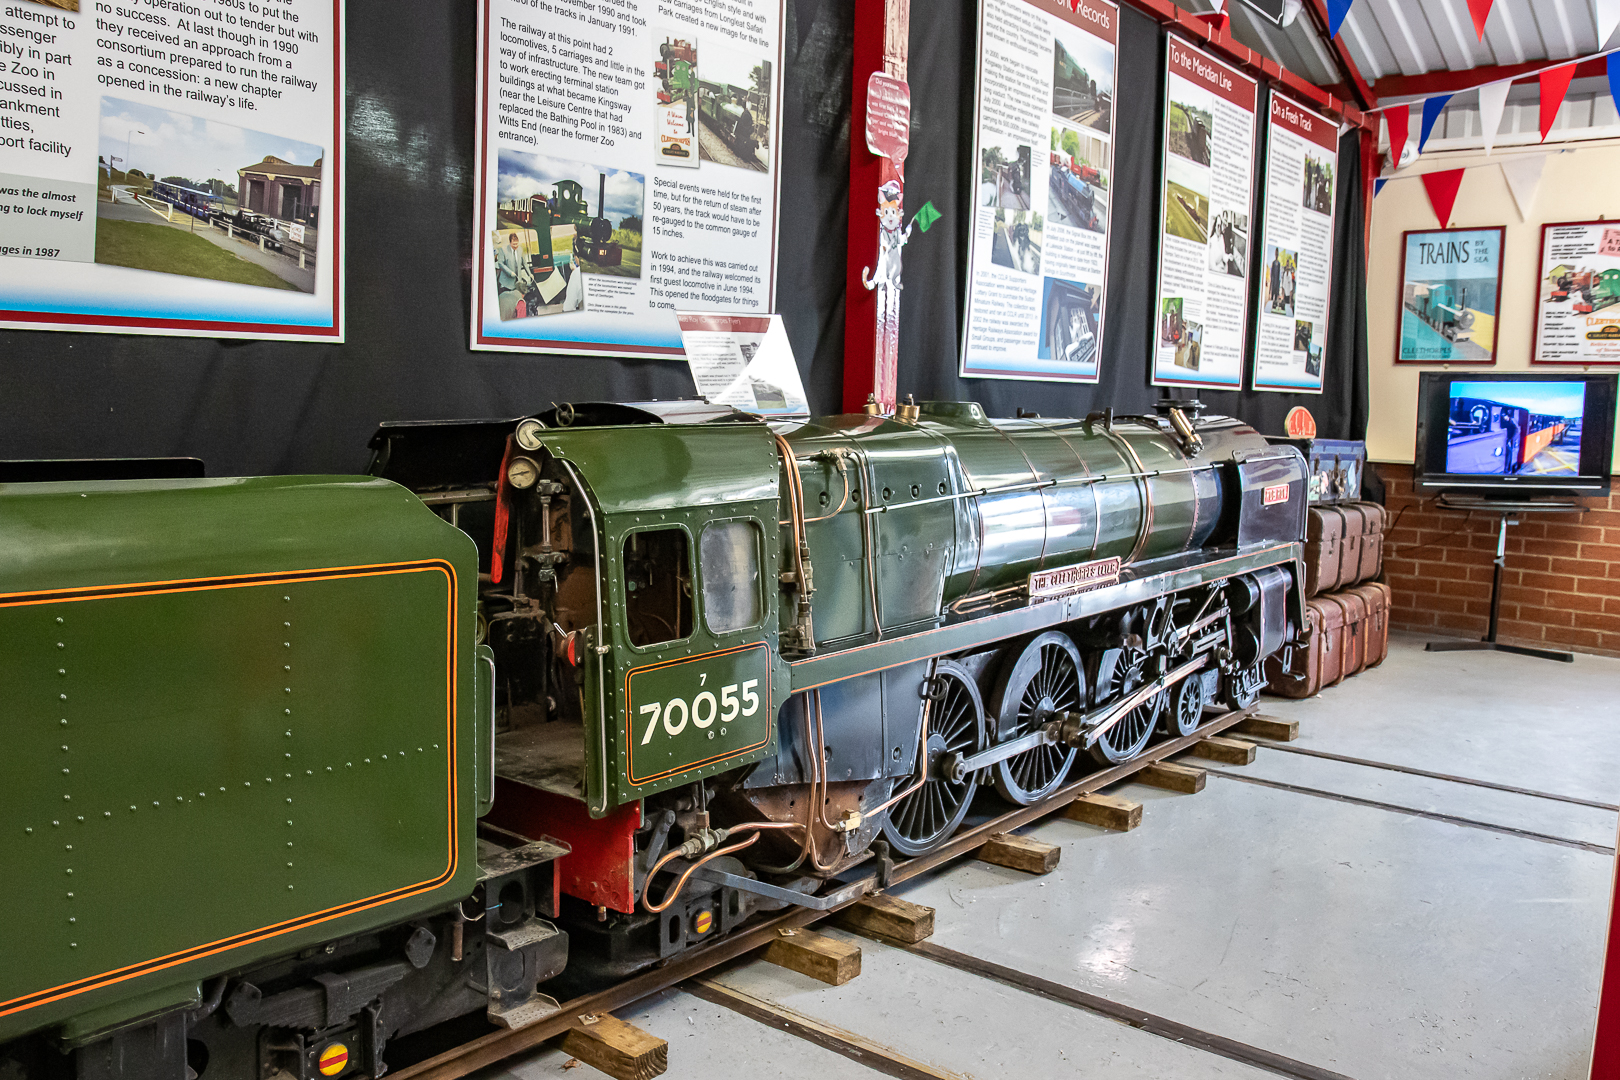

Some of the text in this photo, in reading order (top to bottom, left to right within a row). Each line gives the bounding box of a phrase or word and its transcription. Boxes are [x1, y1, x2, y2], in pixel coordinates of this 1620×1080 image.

[5, 6, 75, 30] attempt to
[204, 9, 223, 22] out
[225, 12, 237, 25] to
[239, 15, 275, 33] tender
[278, 24, 295, 38] but
[297, 30, 318, 43] with
[248, 1, 299, 23] to put the
[1077, 0, 1110, 30] Records
[95, 2, 299, 55] no success. At last though in 1990
[96, 17, 292, 69] they received an approach from a
[500, 16, 613, 56] The railway at this point had 2
[28, 45, 40, 60] in
[45, 52, 72, 66] part
[96, 38, 318, 92] consortium prepared to run the railway
[499, 47, 645, 90] way of infrastructure. The new team got
[500, 30, 645, 77] locomotives, 5 carriages and little in the
[1171, 44, 1232, 92] To the Meridian Line
[10, 60, 39, 78] Zoo
[43, 67, 55, 81] in
[96, 56, 282, 99] as a concession: a new chapter
[0, 99, 60, 118] ankment
[50, 86, 62, 100] in
[97, 74, 257, 111] opened in the railway's life.
[499, 72, 632, 114] buildings at what became Kingsway
[499, 86, 623, 123] (near the Leisure Centre that had
[0, 115, 34, 134] tties,
[498, 102, 534, 117] replaced
[535, 109, 548, 120] the
[550, 111, 579, 129] Bathing
[580, 118, 597, 130] Pool
[607, 124, 627, 138] 1983)
[628, 130, 642, 140] and
[498, 114, 615, 147] Witts End (near the former Zoo
[1272, 100, 1281, 116] On
[1286, 106, 1299, 126] Fresh
[1299, 114, 1312, 132] Track
[28, 137, 72, 158] facility
[498, 130, 538, 146] entrance).
[22, 187, 39, 198] the
[41, 190, 76, 203] almost
[13, 204, 24, 214] to
[26, 205, 48, 216] lock
[49, 210, 84, 222] myself
[22, 245, 32, 255] in
[34, 247, 60, 258] 1987
[1419, 241, 1470, 264] TRAINS
[700, 673, 707, 686] 7
[639, 679, 760, 746] 70055
